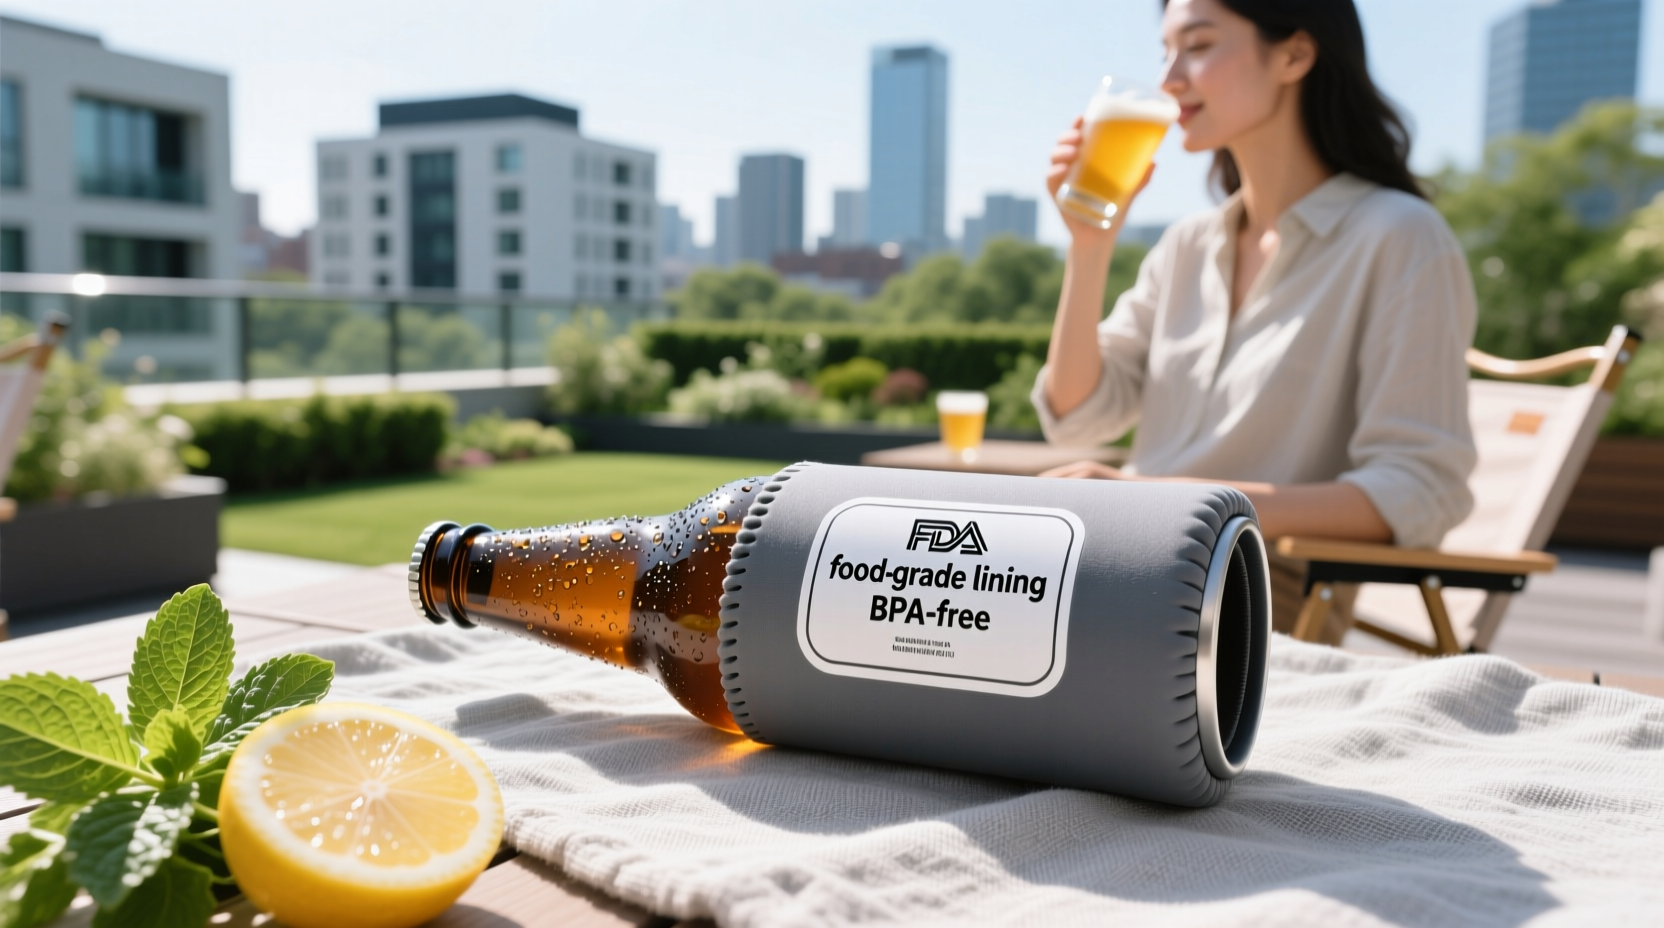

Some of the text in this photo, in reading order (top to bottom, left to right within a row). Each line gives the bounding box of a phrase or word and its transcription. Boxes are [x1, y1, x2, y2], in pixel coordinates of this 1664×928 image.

[906, 519, 988, 555] FDA
[829, 554, 1047, 602] food-grade lining
[869, 595, 991, 631] BPA-free
